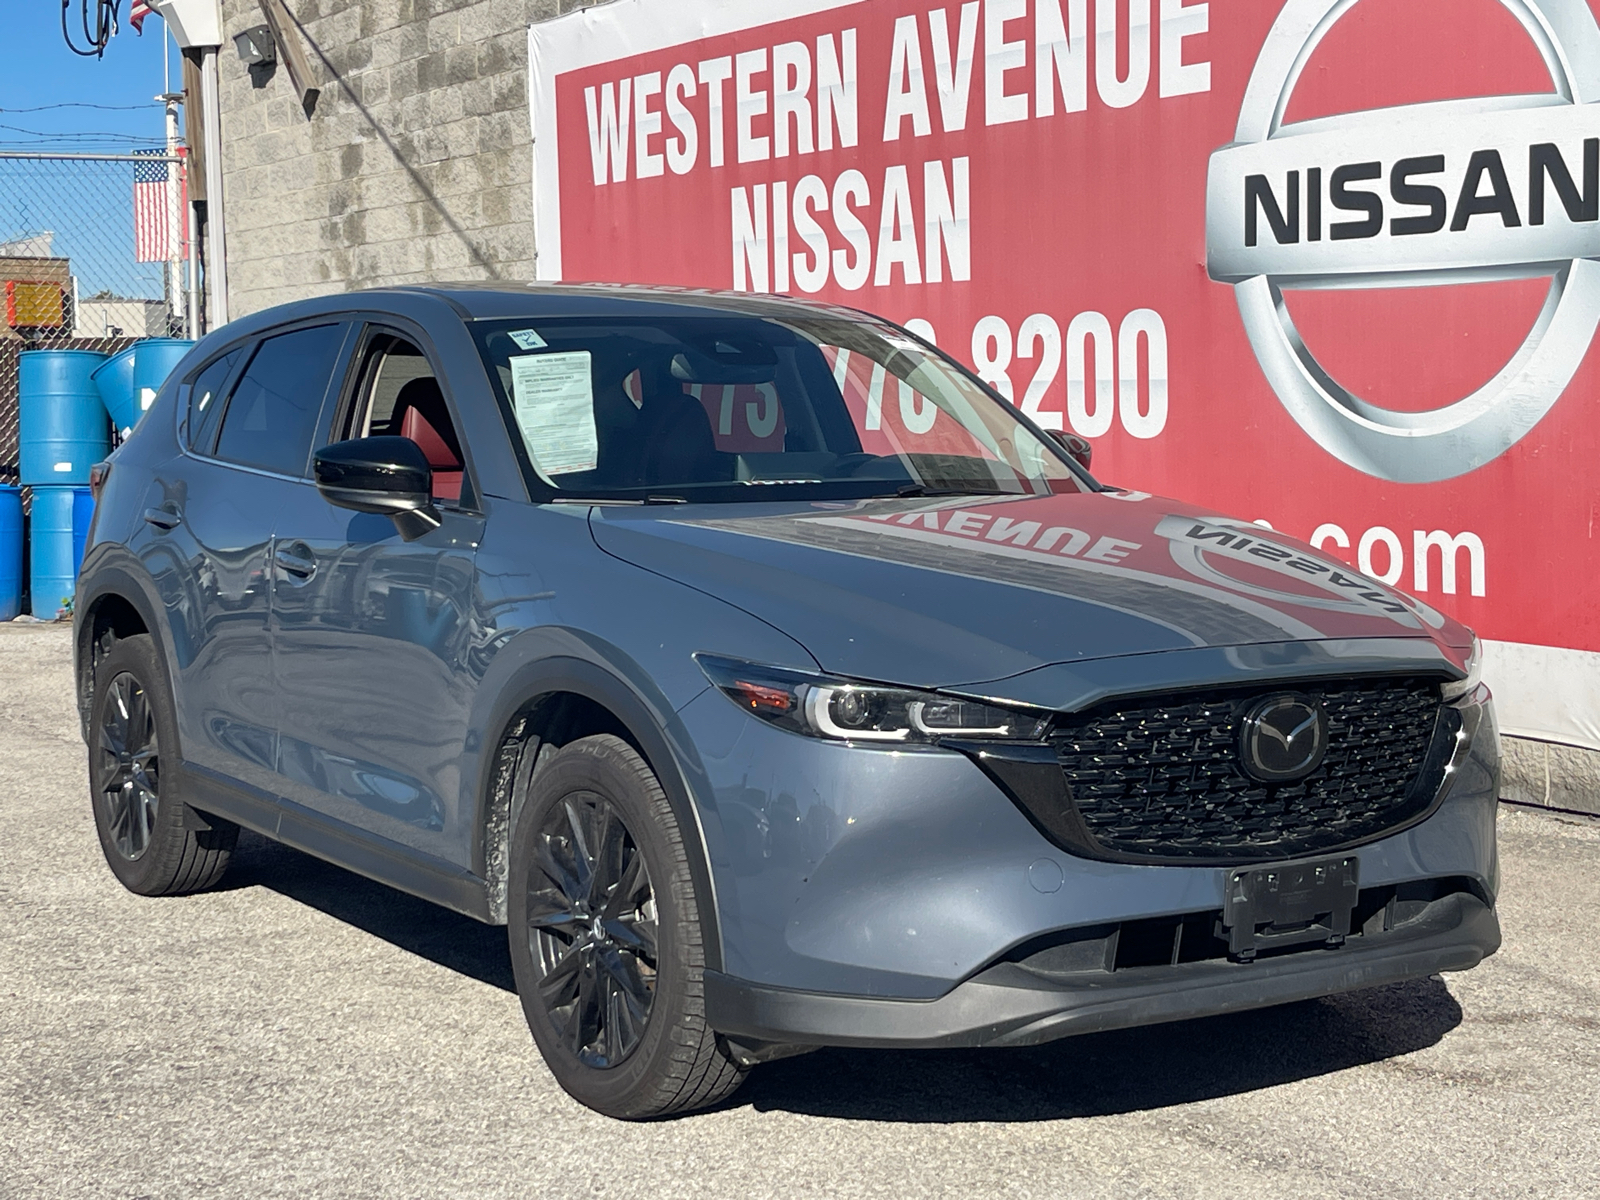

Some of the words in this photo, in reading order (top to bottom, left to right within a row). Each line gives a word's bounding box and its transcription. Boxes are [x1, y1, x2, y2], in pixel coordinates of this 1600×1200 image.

[585, 28, 858, 186] WESTERN
[883, 0, 1212, 142] AVENUE
[731, 156, 971, 293] NISSAN
[1245, 137, 1600, 247] NISSAN
[971, 308, 1168, 438] 8200
